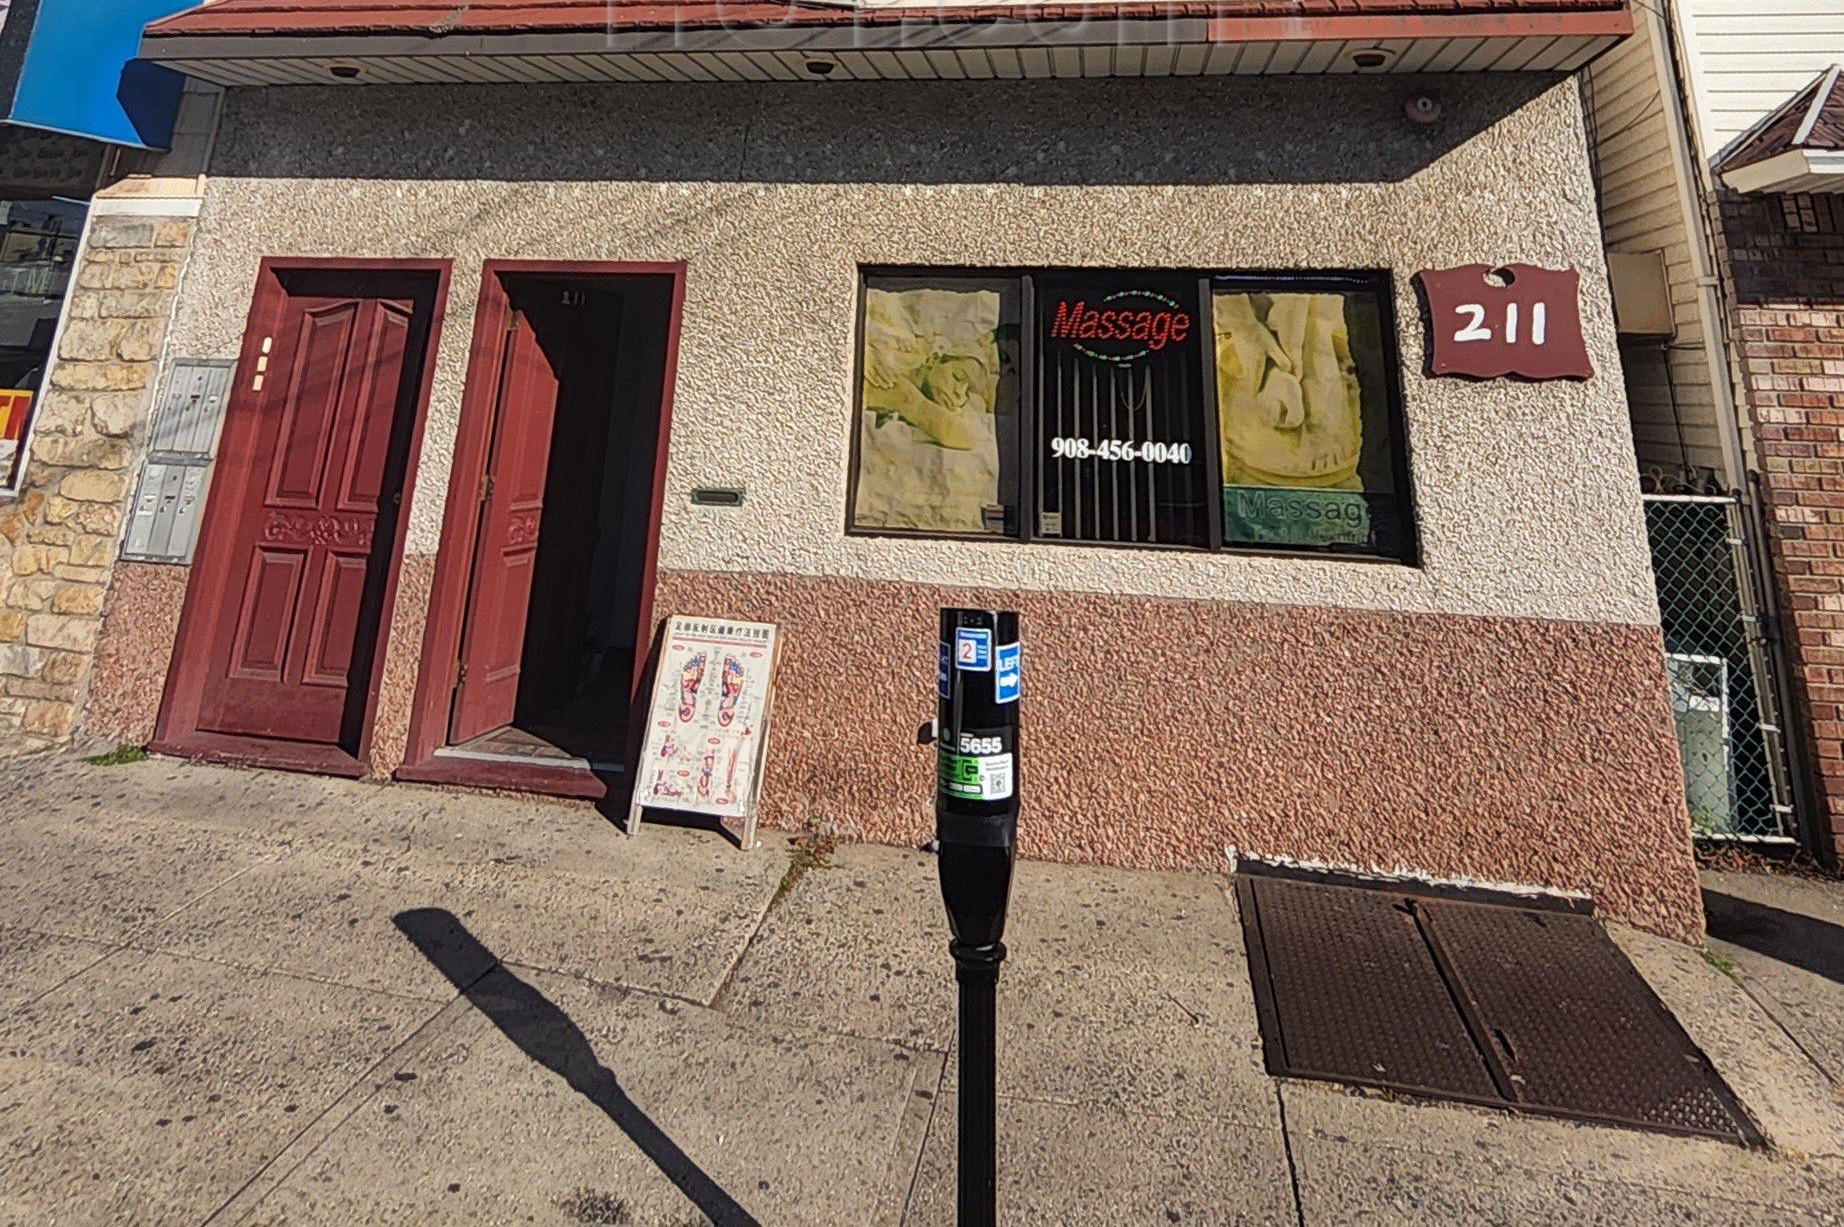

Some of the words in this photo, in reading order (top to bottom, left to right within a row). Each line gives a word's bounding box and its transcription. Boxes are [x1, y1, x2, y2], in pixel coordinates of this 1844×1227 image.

[560, 289, 587, 306] 211
[1051, 300, 1190, 351] Massage
[1453, 301, 1546, 345] 211
[1051, 437, 1193, 464] 908-456-0040
[962, 642, 972, 660] 2
[960, 737, 1003, 754] 5655
